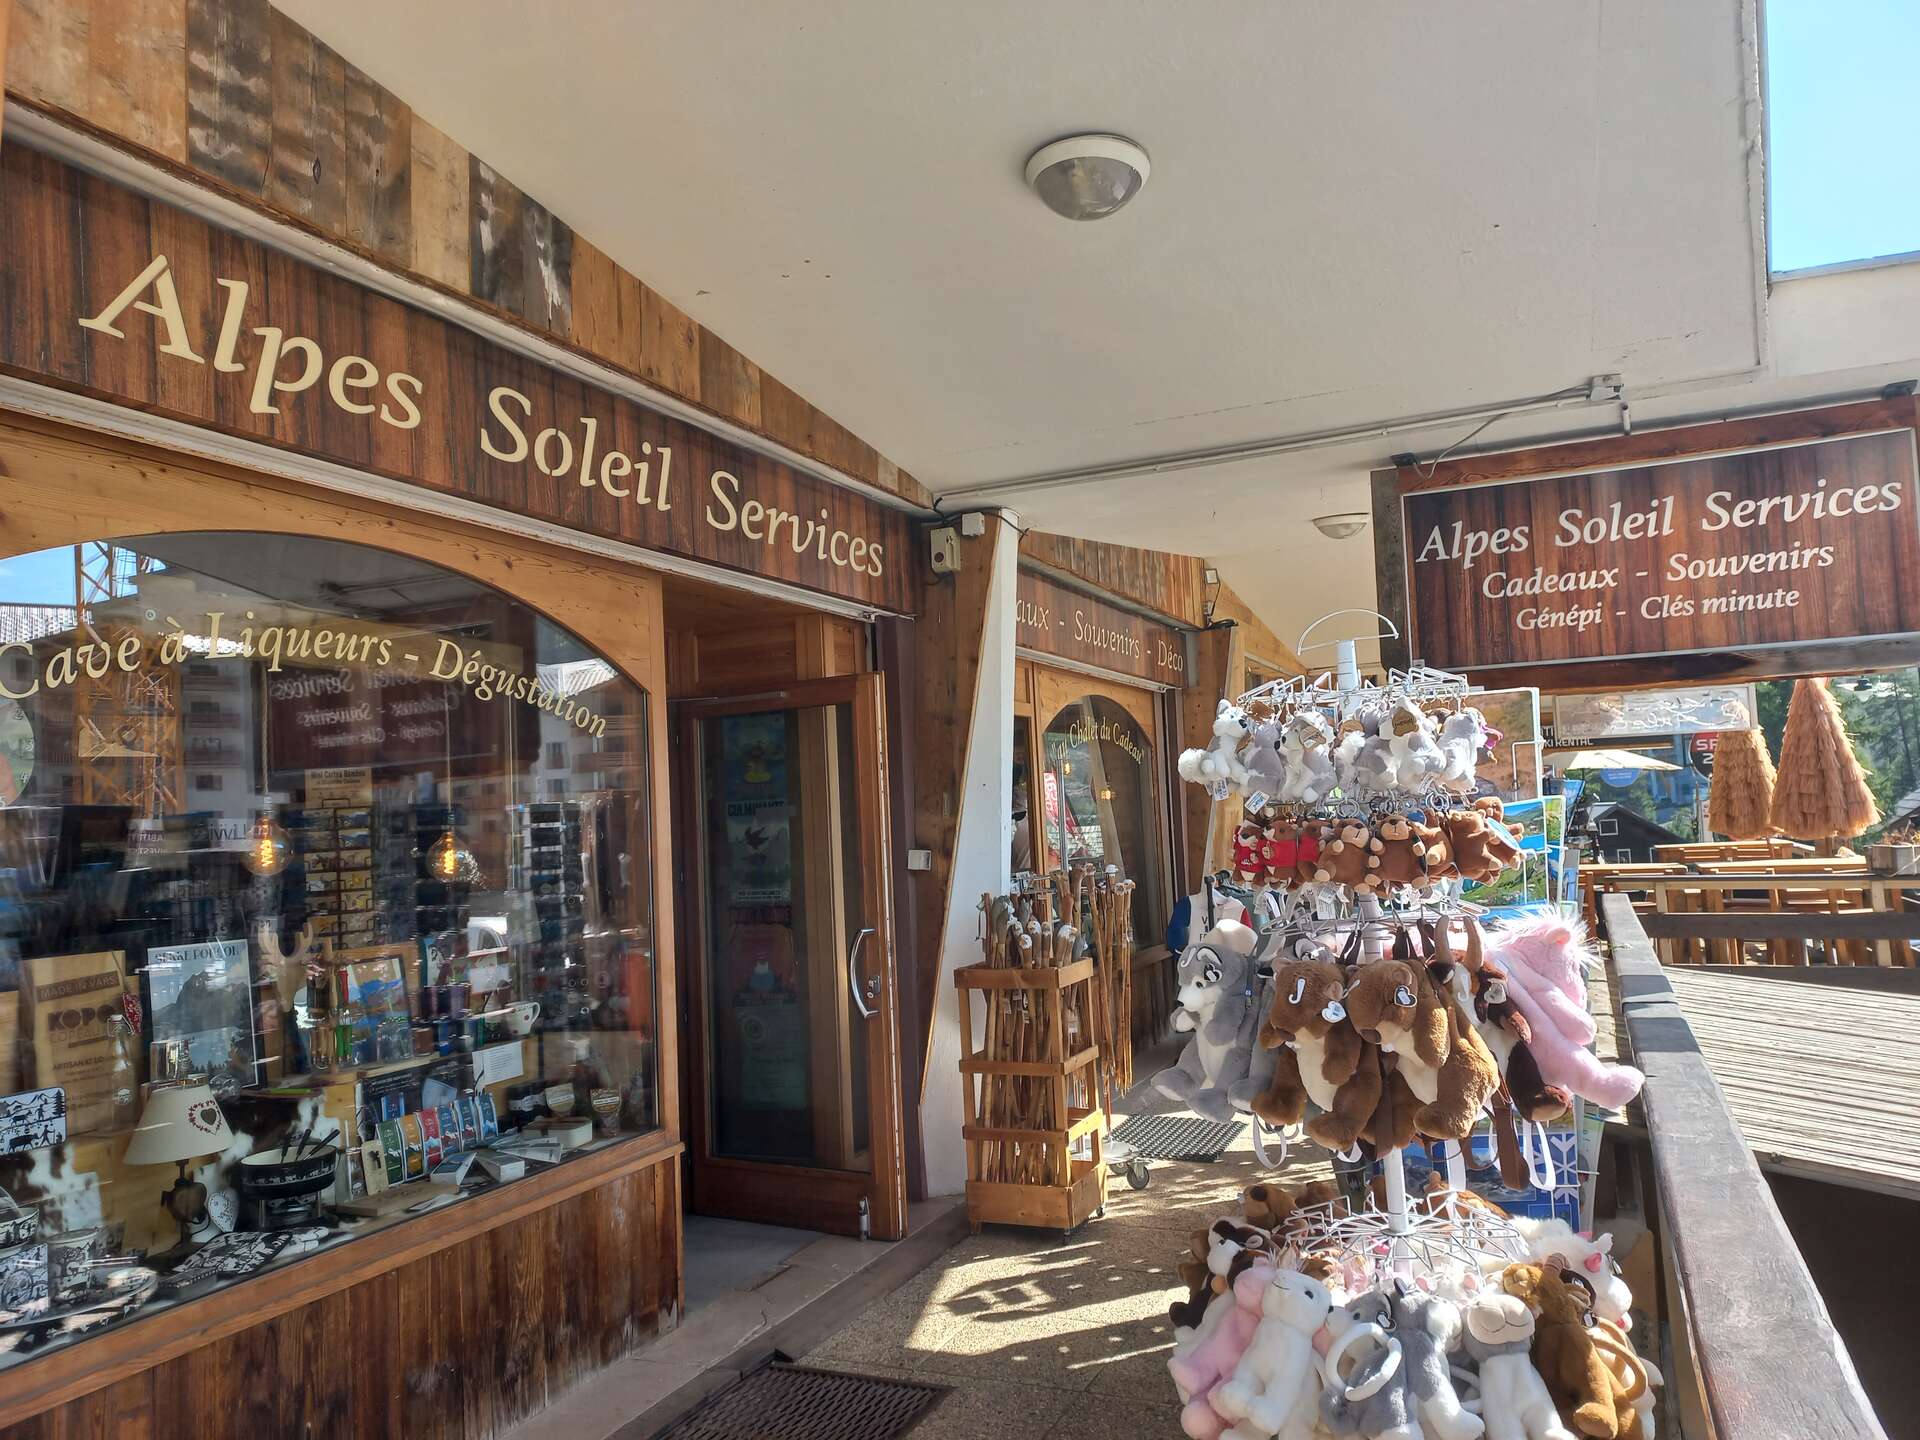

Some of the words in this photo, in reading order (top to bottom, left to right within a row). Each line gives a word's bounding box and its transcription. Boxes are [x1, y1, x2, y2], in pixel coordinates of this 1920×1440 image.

[78, 254, 424, 430] Alpes
[480, 386, 672, 512] Soleil
[706, 470, 884, 577] Services
[1416, 520, 1530, 569] Alpes
[1554, 496, 1675, 547] Soleil
[1701, 478, 1903, 531] Services
[1482, 567, 1619, 600] Cadeaux
[1666, 543, 1835, 582] Souvenirs
[1016, 600, 1050, 631] aux
[1074, 610, 1140, 659] Souvenirs
[1157, 639, 1184, 672] Déco
[1516, 603, 1603, 632] Génépi
[1640, 595, 1695, 620] Clés
[1702, 587, 1800, 615] minute
[0, 635, 141, 699] Cave
[160, 617, 189, 665] à
[204, 611, 393, 672] Liqueurs
[429, 638, 607, 738] Dégustation
[1070, 716, 1098, 748] Chalet
[1101, 716, 1111, 741] du
[1555, 737, 1594, 748] RENTAL
